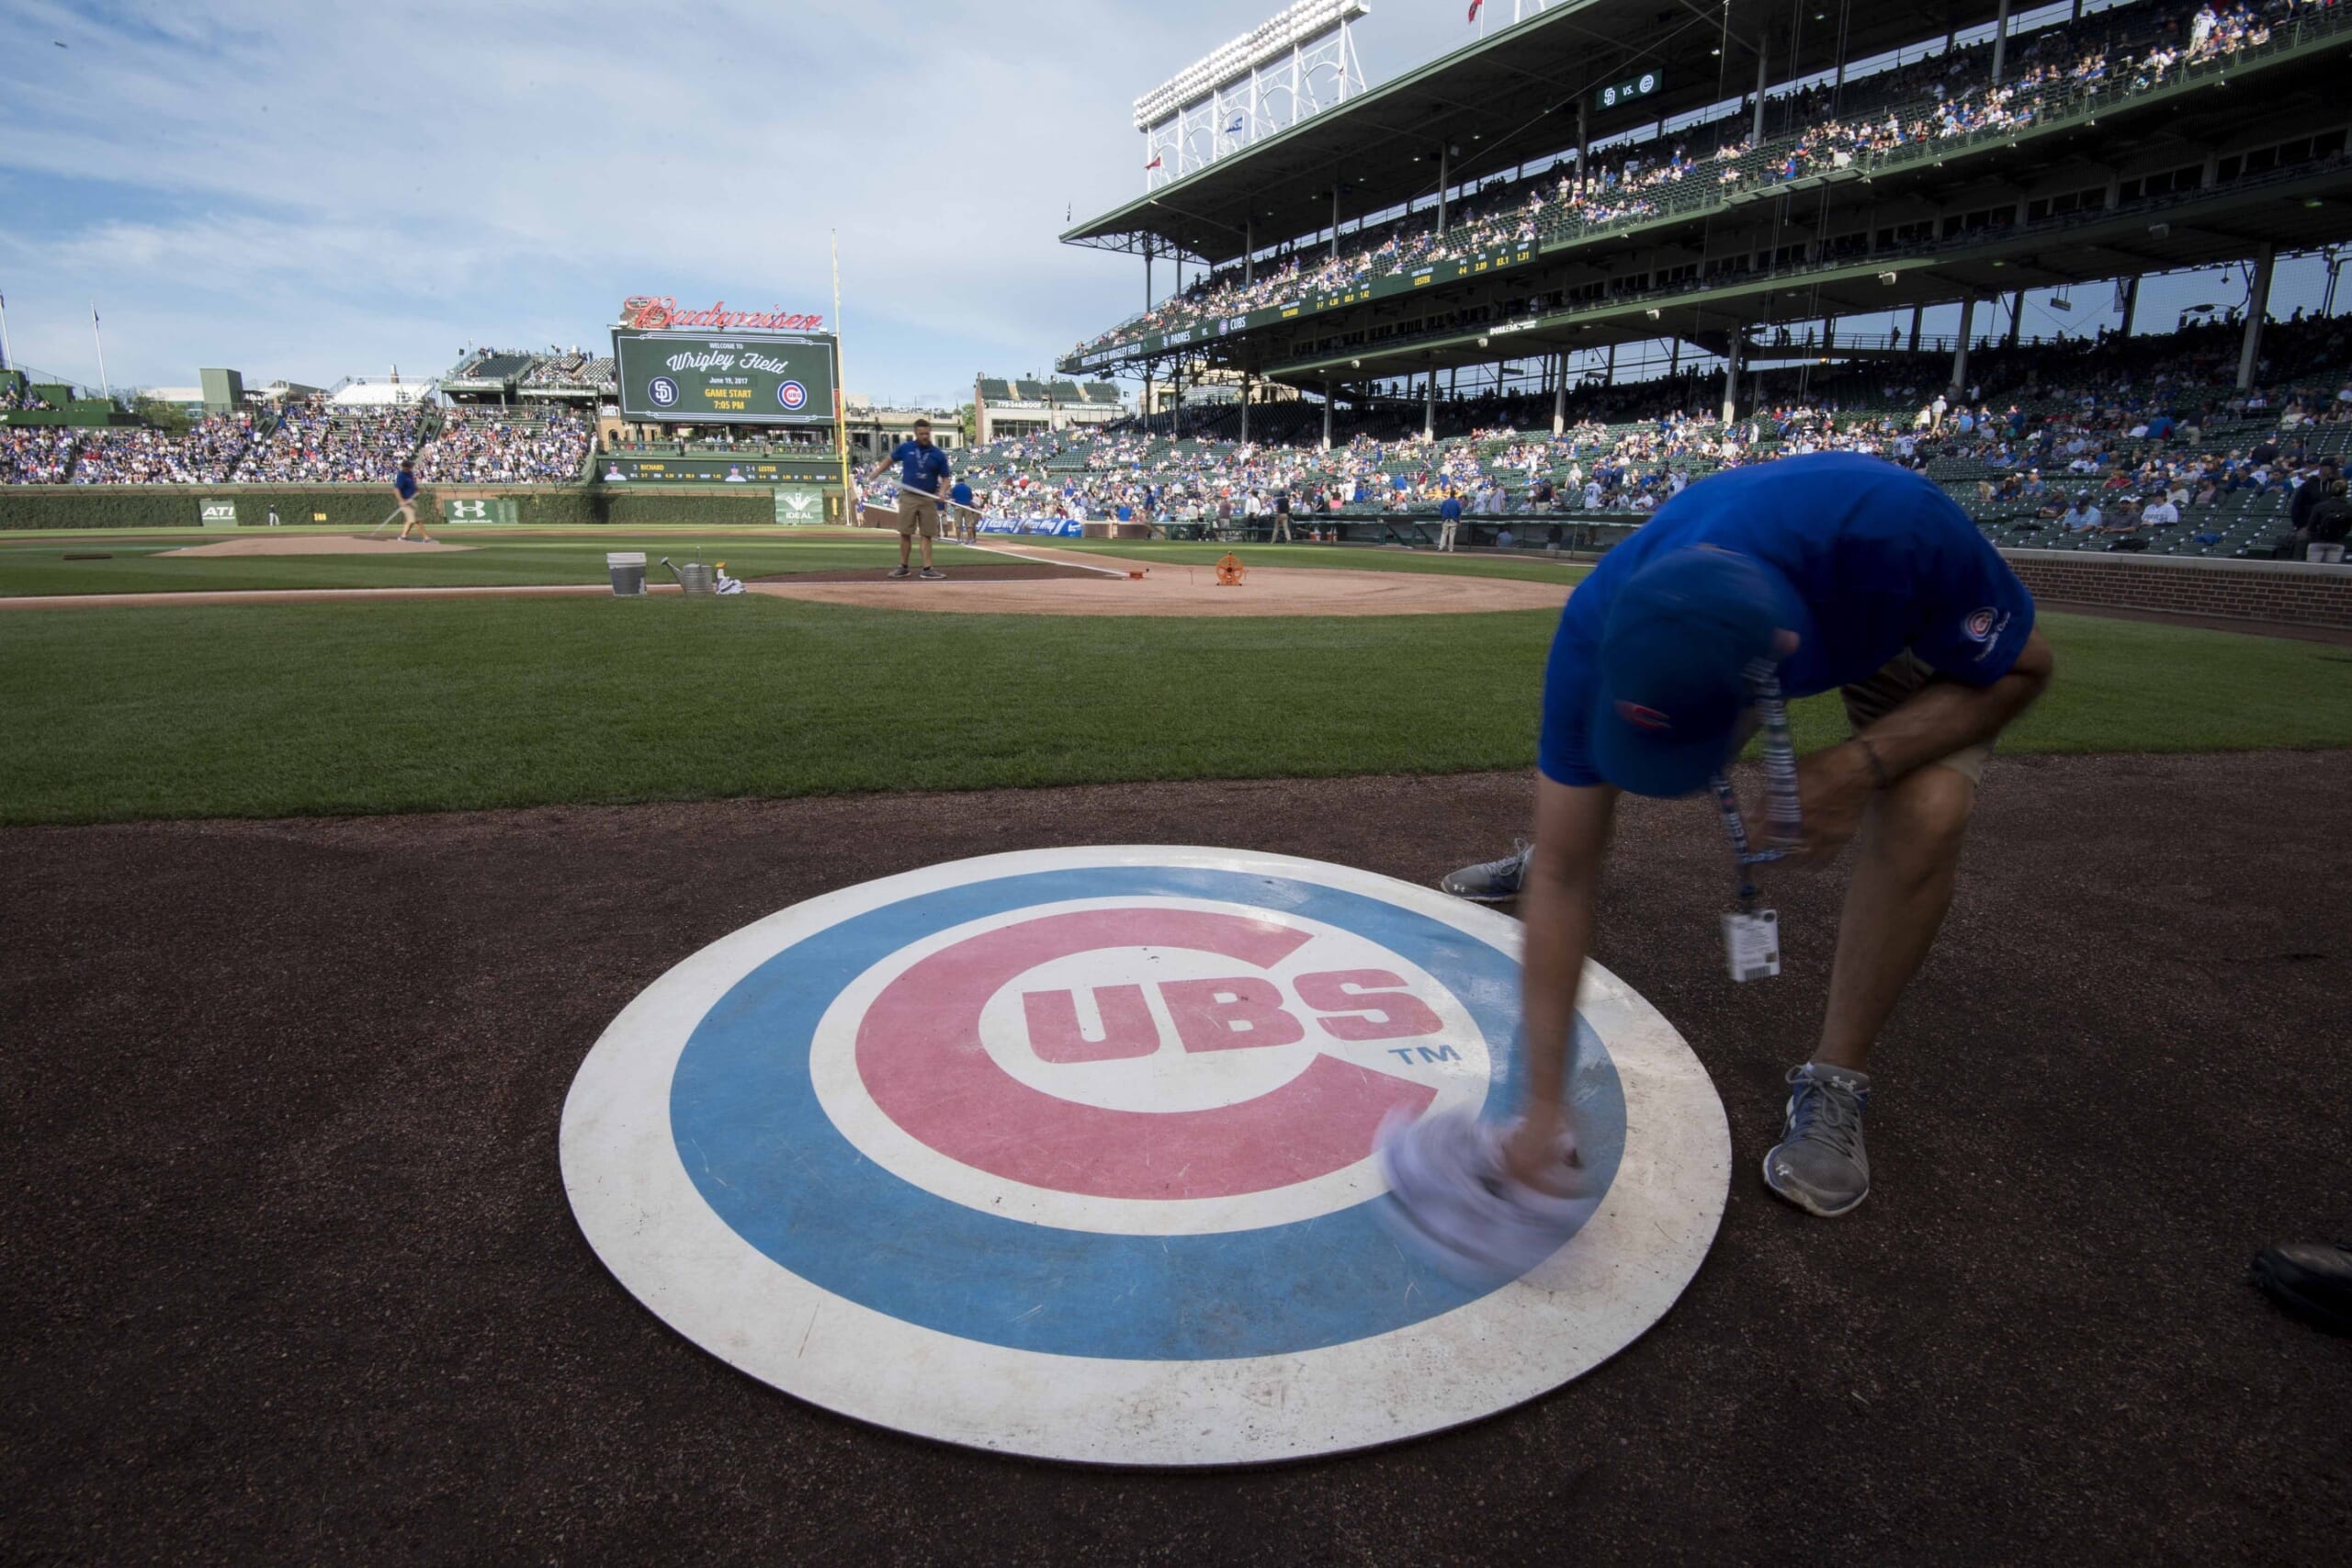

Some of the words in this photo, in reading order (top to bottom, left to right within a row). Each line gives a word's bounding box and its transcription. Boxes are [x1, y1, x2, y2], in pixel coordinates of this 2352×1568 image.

[625, 295, 823, 331] Budweiser
[1230, 316, 1246, 330] CUBS
[1170, 331, 1191, 345] PADRES
[1080, 355, 1102, 367] WELCOME
[1102, 352, 1108, 362] TO
[1108, 347, 1127, 360] WRIGLEY
[1128, 343, 1141, 355] FIELD
[666, 350, 734, 372] Wrigley
[740, 353, 788, 375] Field
[705, 389, 728, 398] GAME
[729, 389, 752, 399] START
[714, 400, 730, 409] 7:05
[732, 401, 744, 410] PM
[203, 506, 234, 516] ATI
[1387, 1043, 1464, 1066] TM
